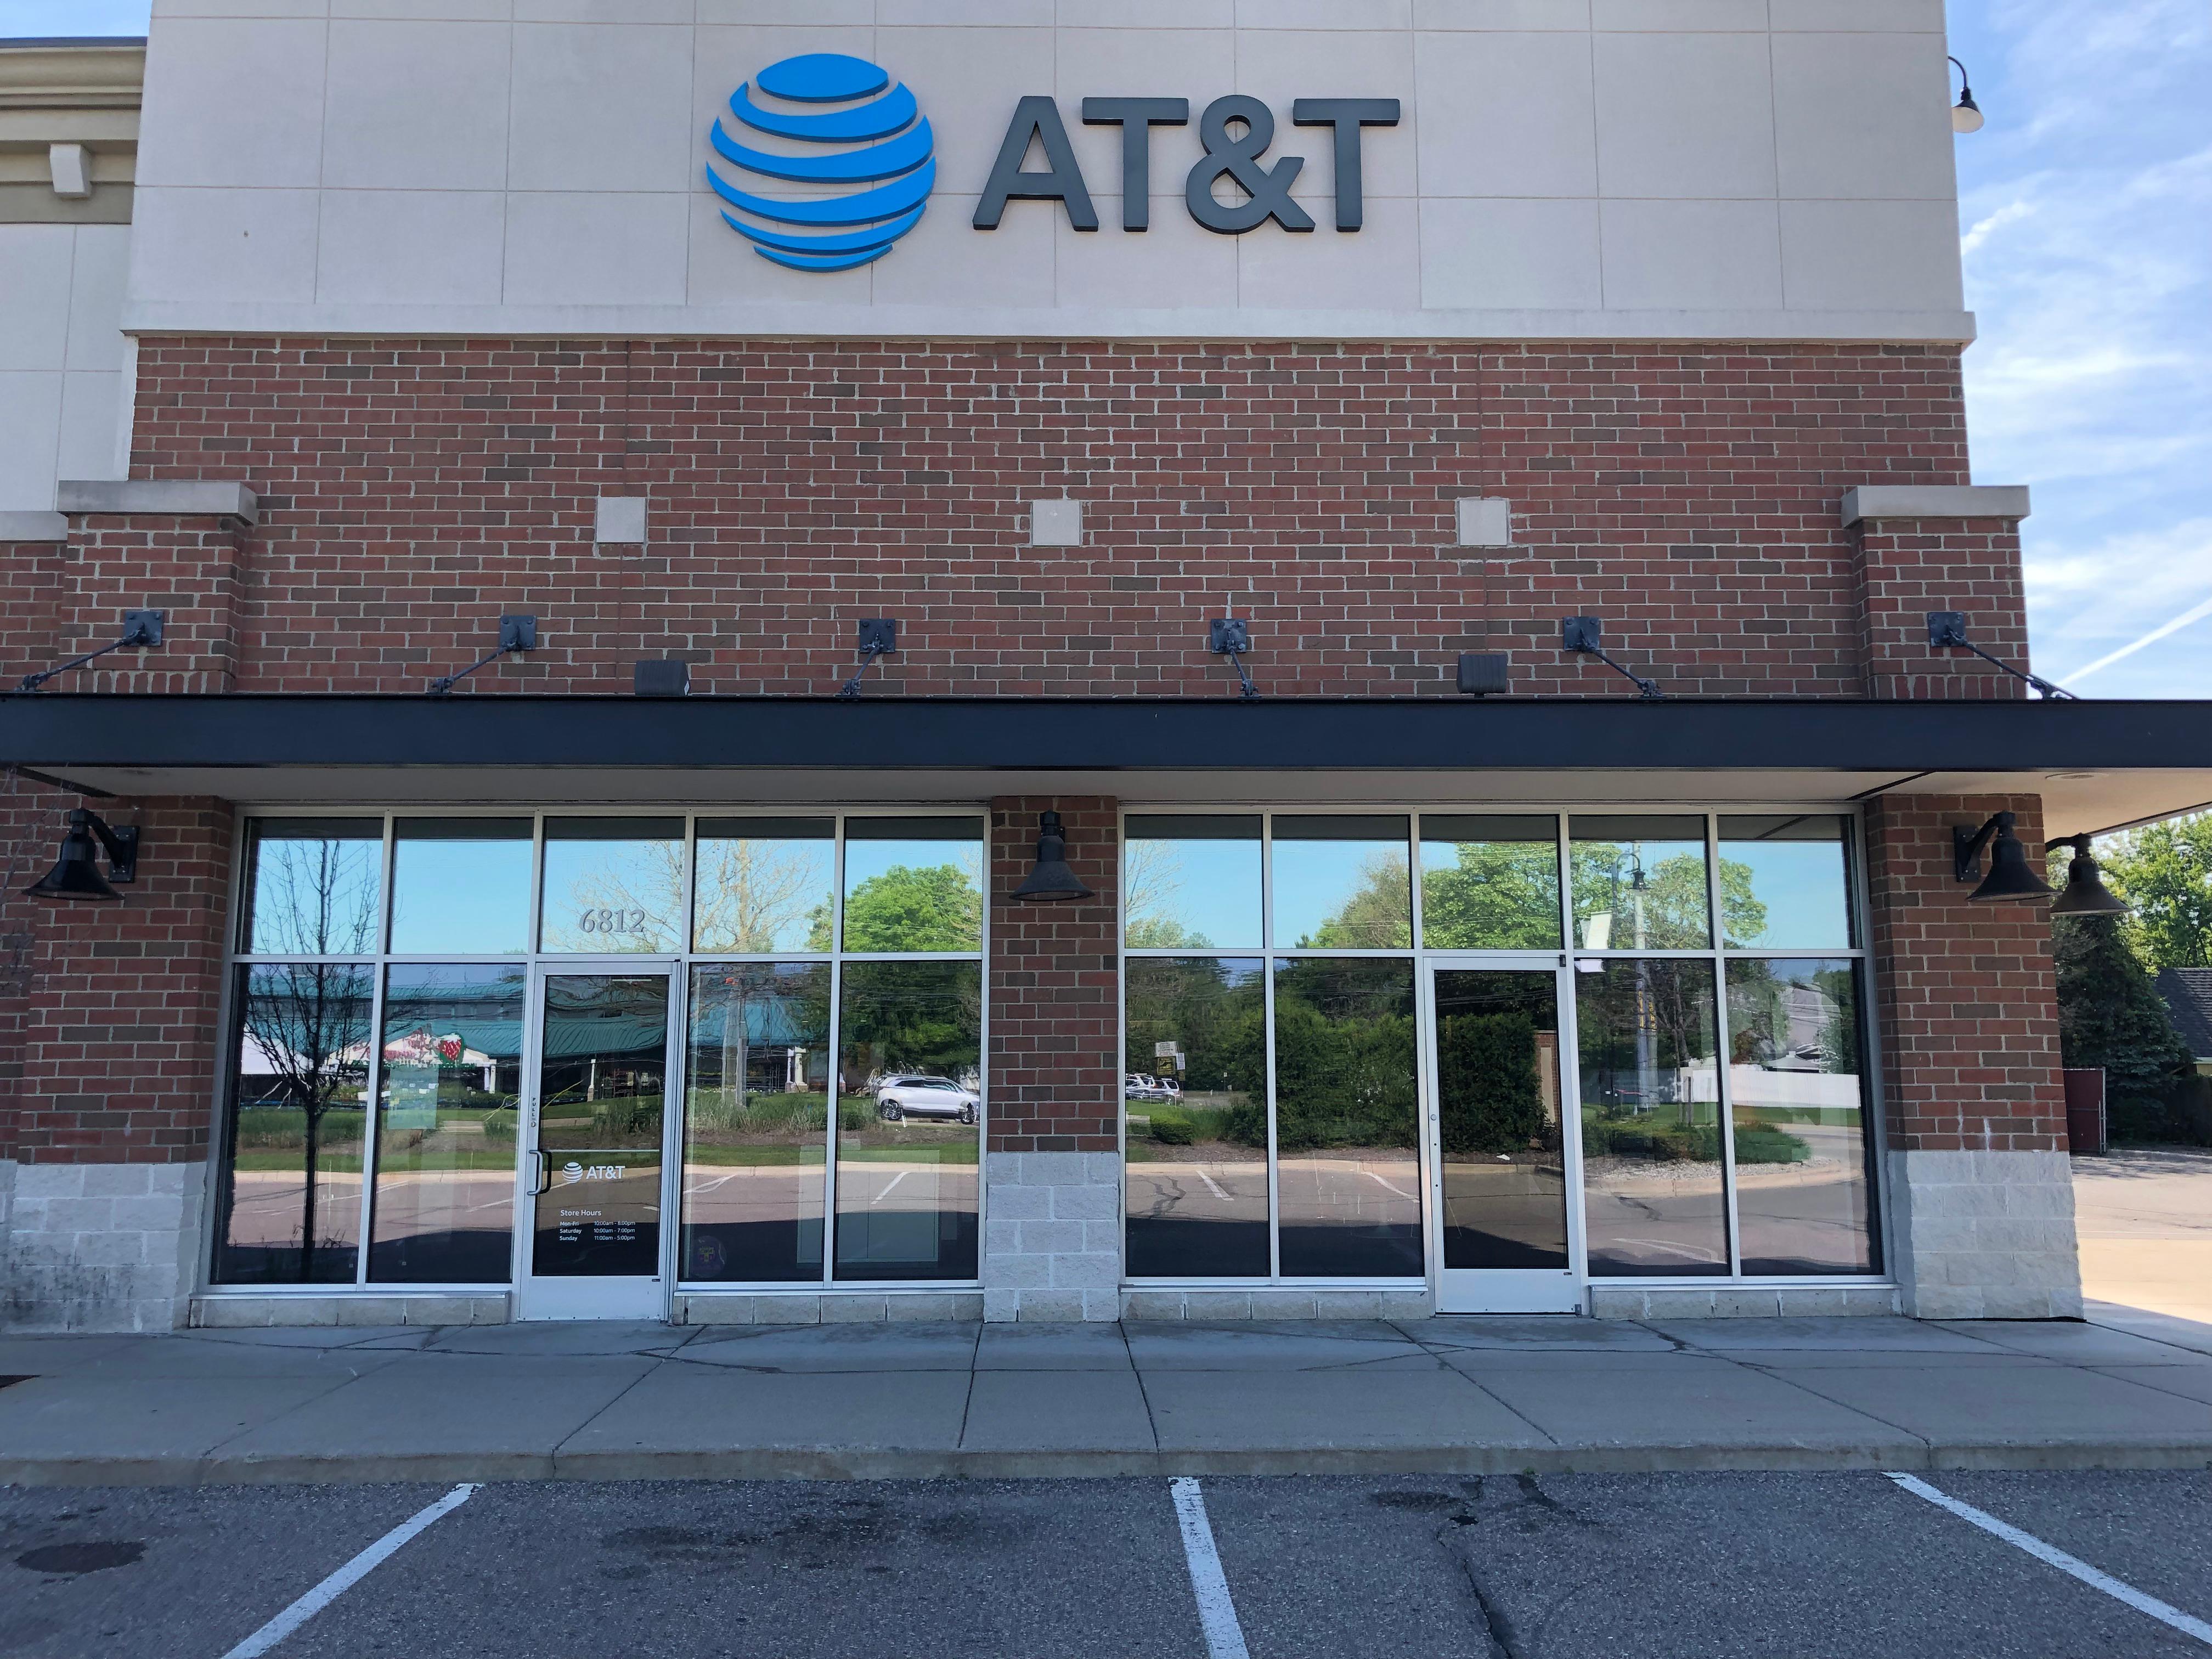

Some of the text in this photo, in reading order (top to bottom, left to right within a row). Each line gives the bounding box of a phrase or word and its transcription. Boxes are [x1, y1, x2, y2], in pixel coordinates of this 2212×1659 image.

[972, 94, 1401, 235] AT&T
[579, 909, 645, 933] 6812
[586, 1165, 625, 1180] AT&T
